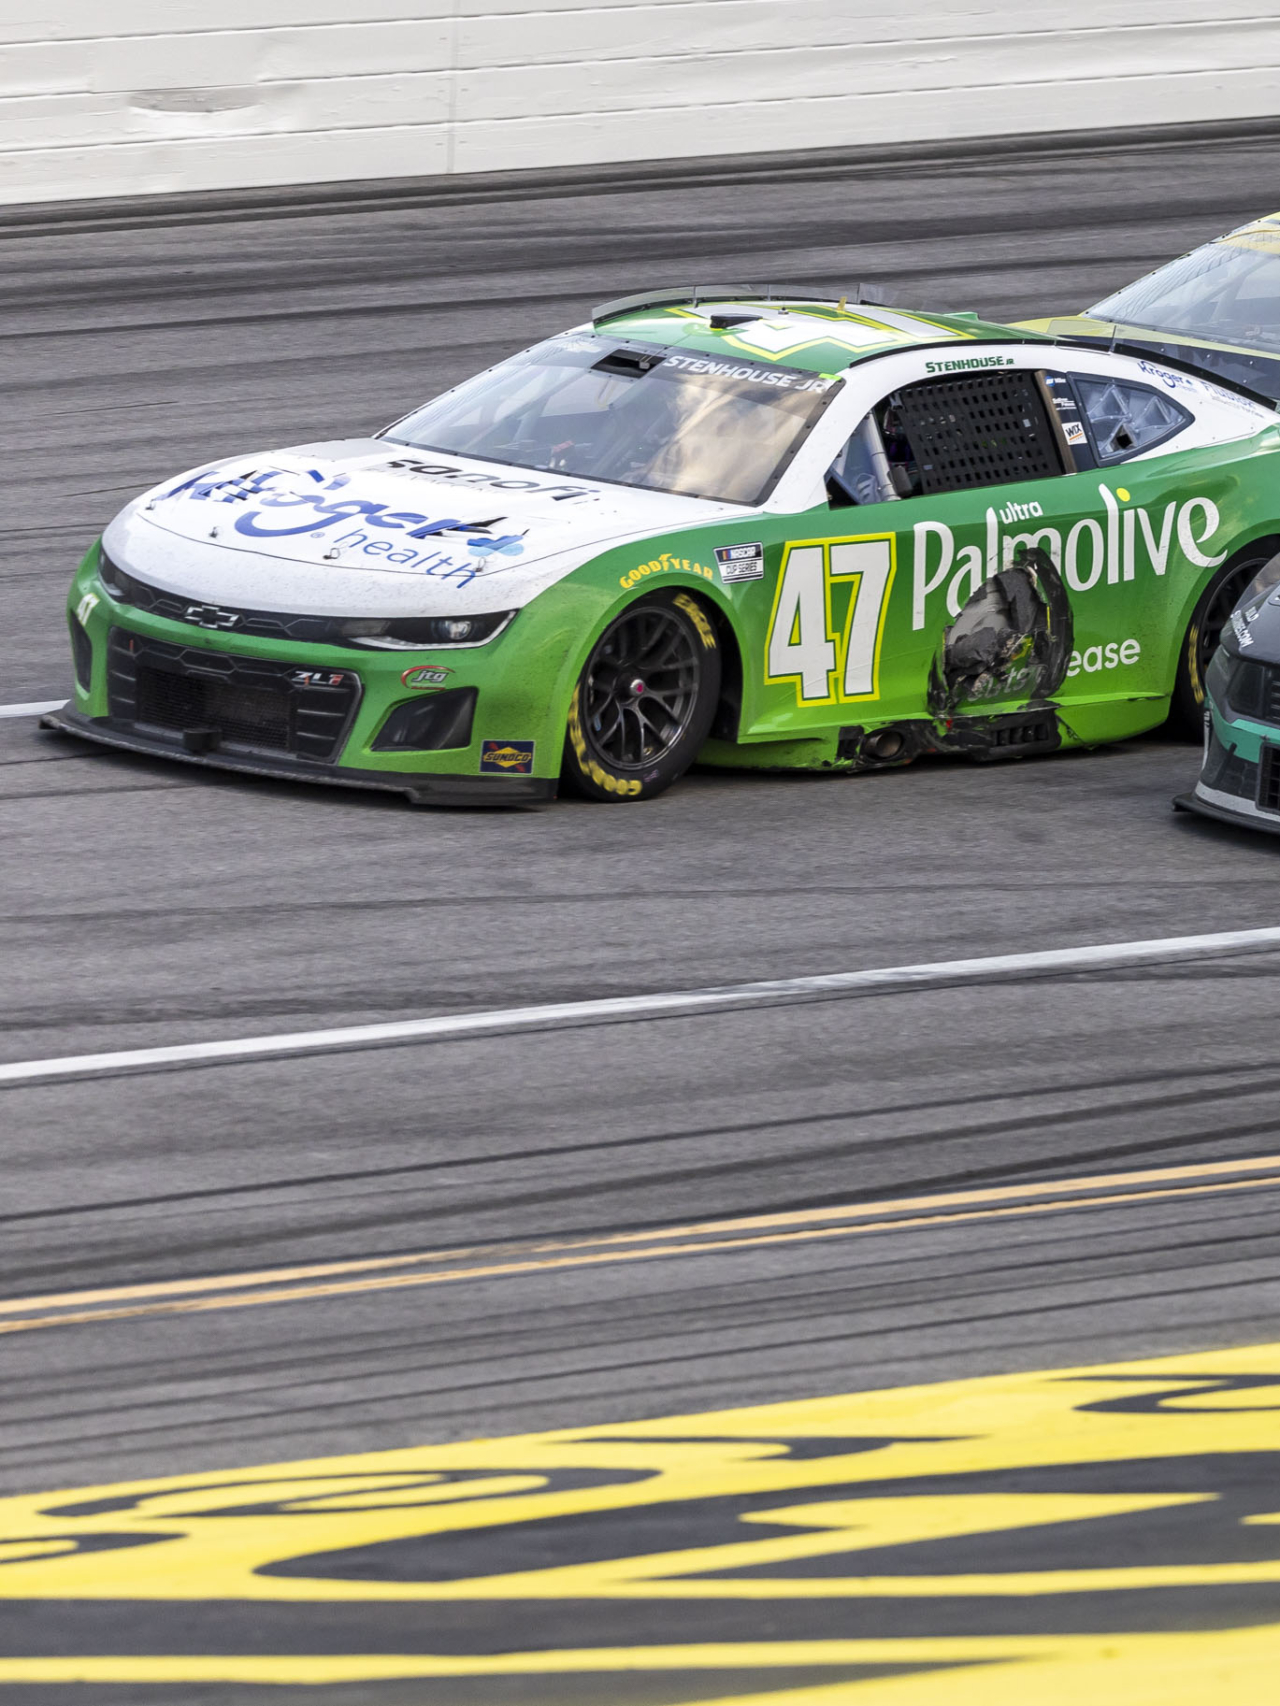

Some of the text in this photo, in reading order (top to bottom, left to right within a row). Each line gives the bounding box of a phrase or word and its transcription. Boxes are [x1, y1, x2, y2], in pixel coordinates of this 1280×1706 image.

[662, 355, 798, 387] STENHOUSE
[925, 356, 1004, 373] STENHOUSE
[1139, 360, 1184, 389] Kroger
[1000, 501, 1044, 525] ultra
[333, 529, 477, 589] health
[619, 554, 714, 589] GOODYEAR
[912, 484, 1229, 631] Palmolive
[766, 533, 895, 704] 47
[292, 671, 344, 686] ZL1
[411, 671, 448, 683] jtg
[484, 752, 532, 763] SUNOCO
